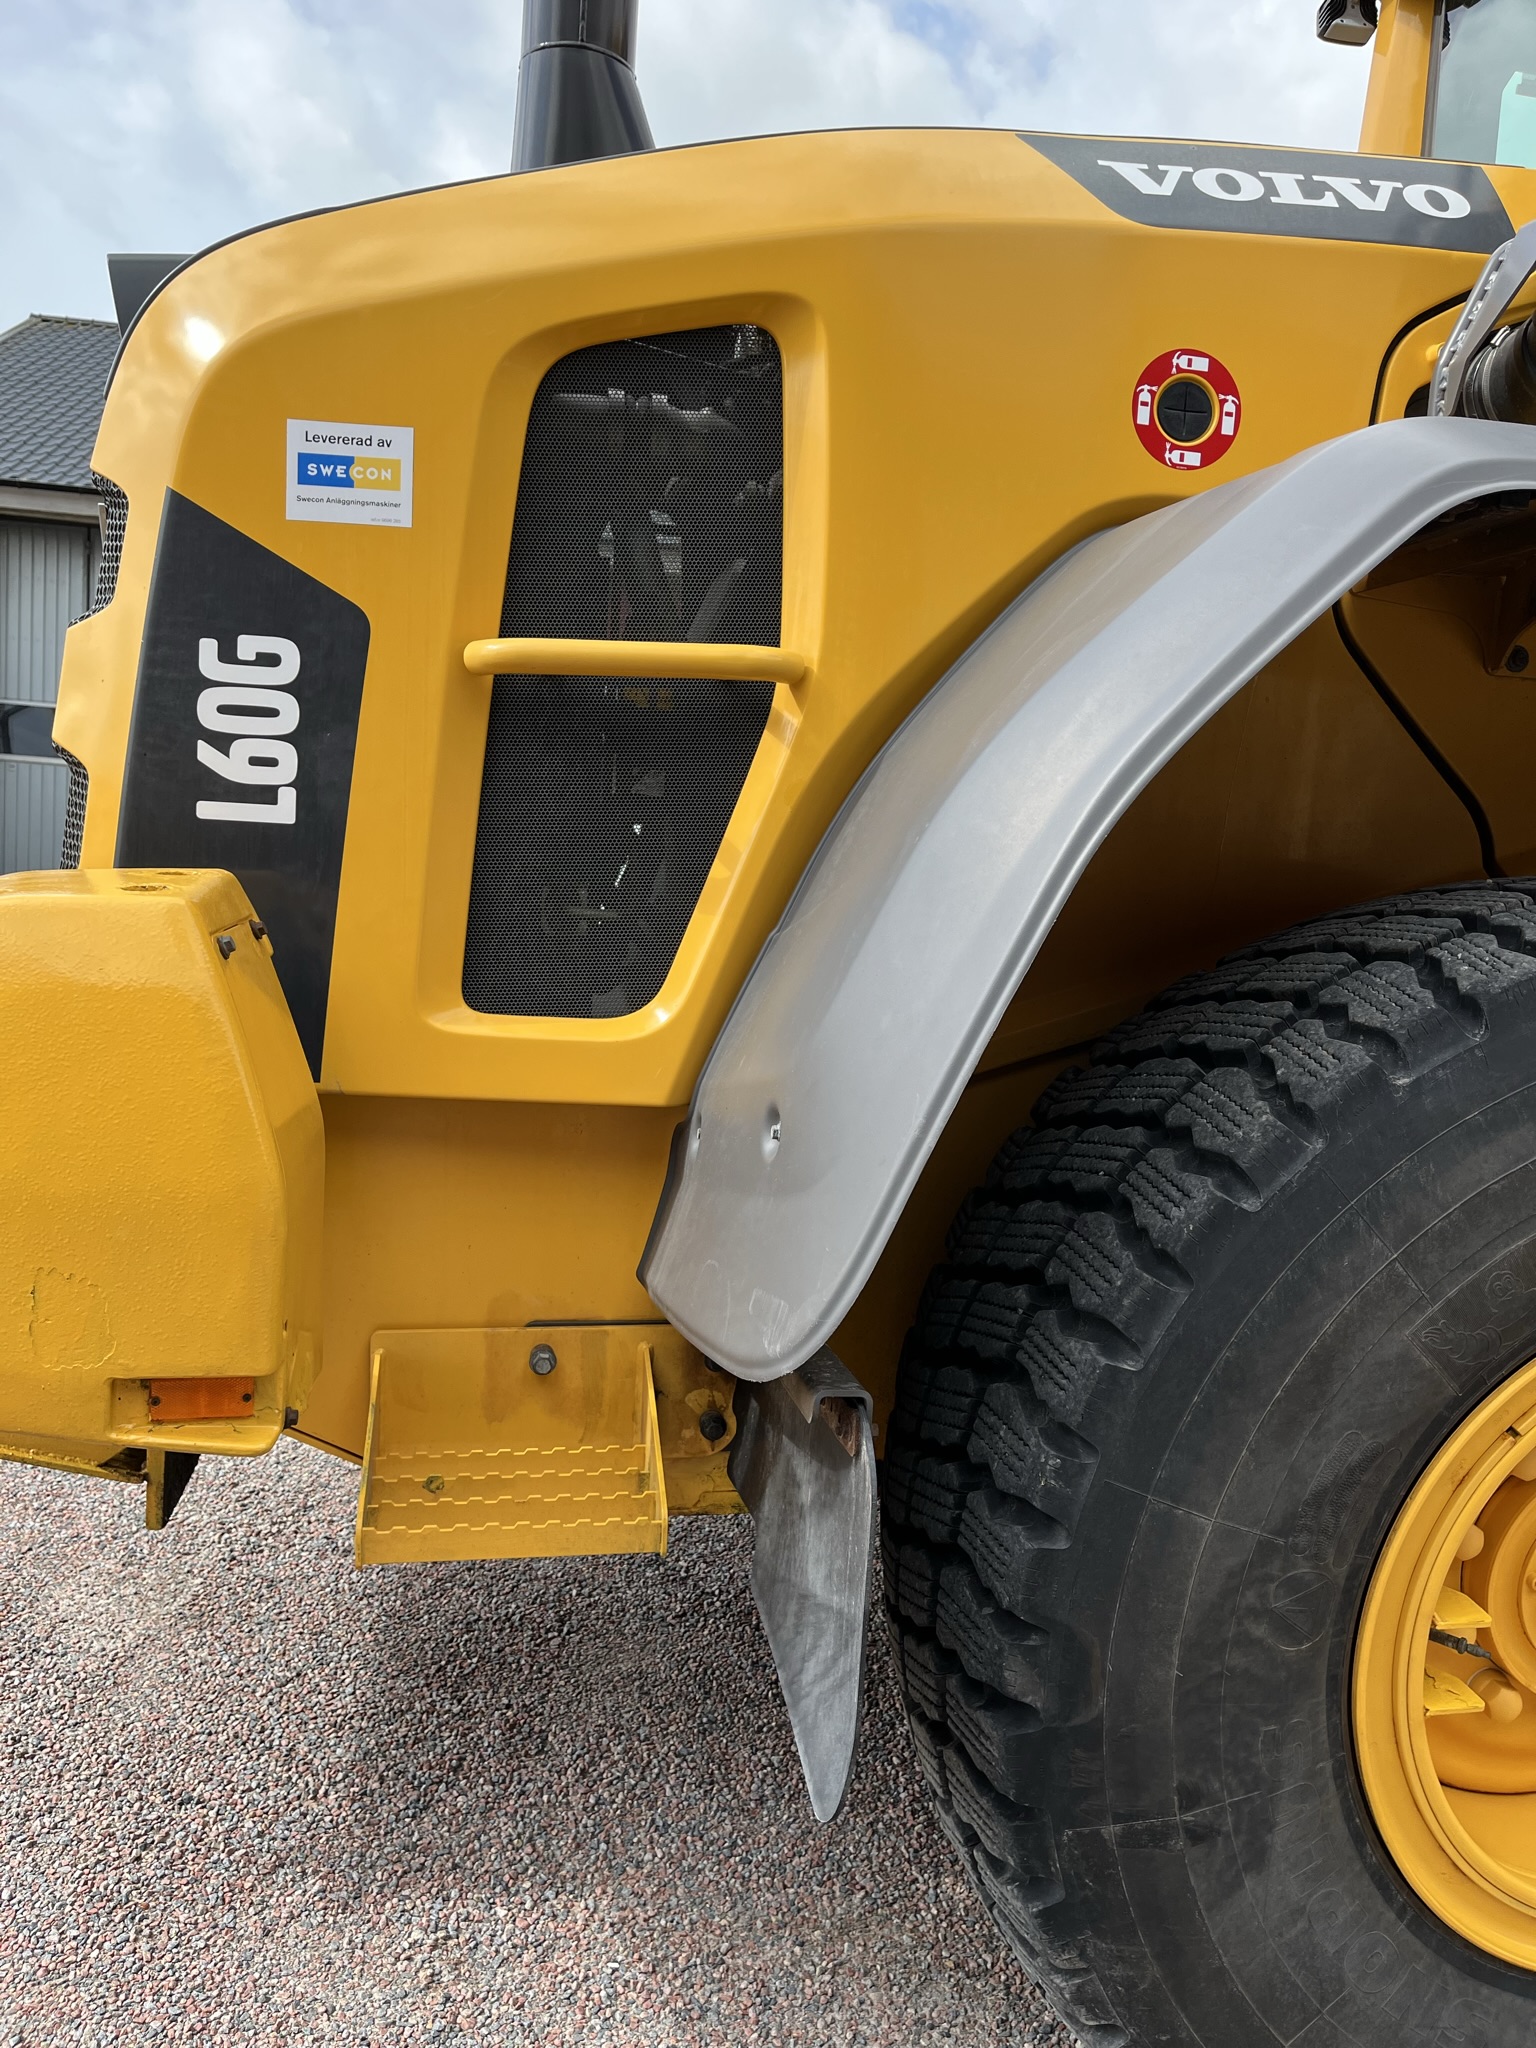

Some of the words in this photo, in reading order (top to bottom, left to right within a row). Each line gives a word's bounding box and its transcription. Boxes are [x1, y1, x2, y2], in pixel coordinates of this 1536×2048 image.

[1096, 159, 1471, 219] VOLVO
[305, 430, 373, 447] Levererad
[377, 438, 392, 448] av
[307, 463, 392, 481] SWECON
[296, 495, 324, 503] Swecon
[326, 497, 401, 508] Anläggningsmaskiner
[196, 634, 301, 825] L60G
